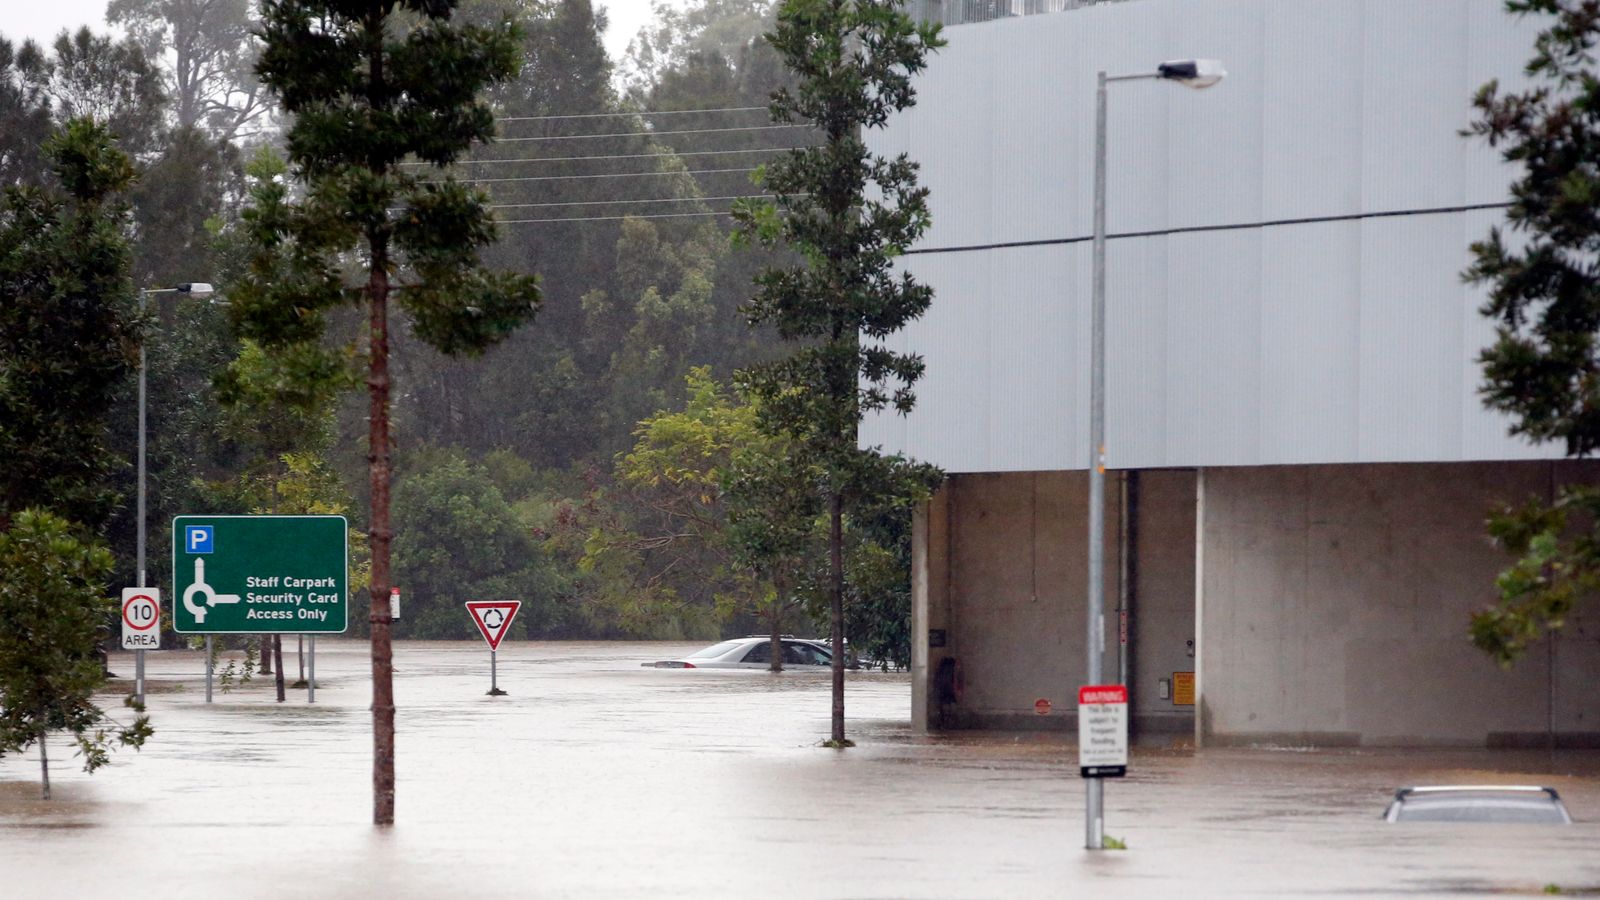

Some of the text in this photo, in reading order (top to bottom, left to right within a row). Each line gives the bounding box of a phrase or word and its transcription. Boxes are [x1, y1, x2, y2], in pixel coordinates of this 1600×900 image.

[191, 529, 208, 549] P
[246, 576, 336, 591] Staff Carpark
[246, 592, 338, 607] Security Card
[132, 604, 152, 620] 10
[246, 608, 328, 622] Access Only
[125, 635, 157, 646] AREA
